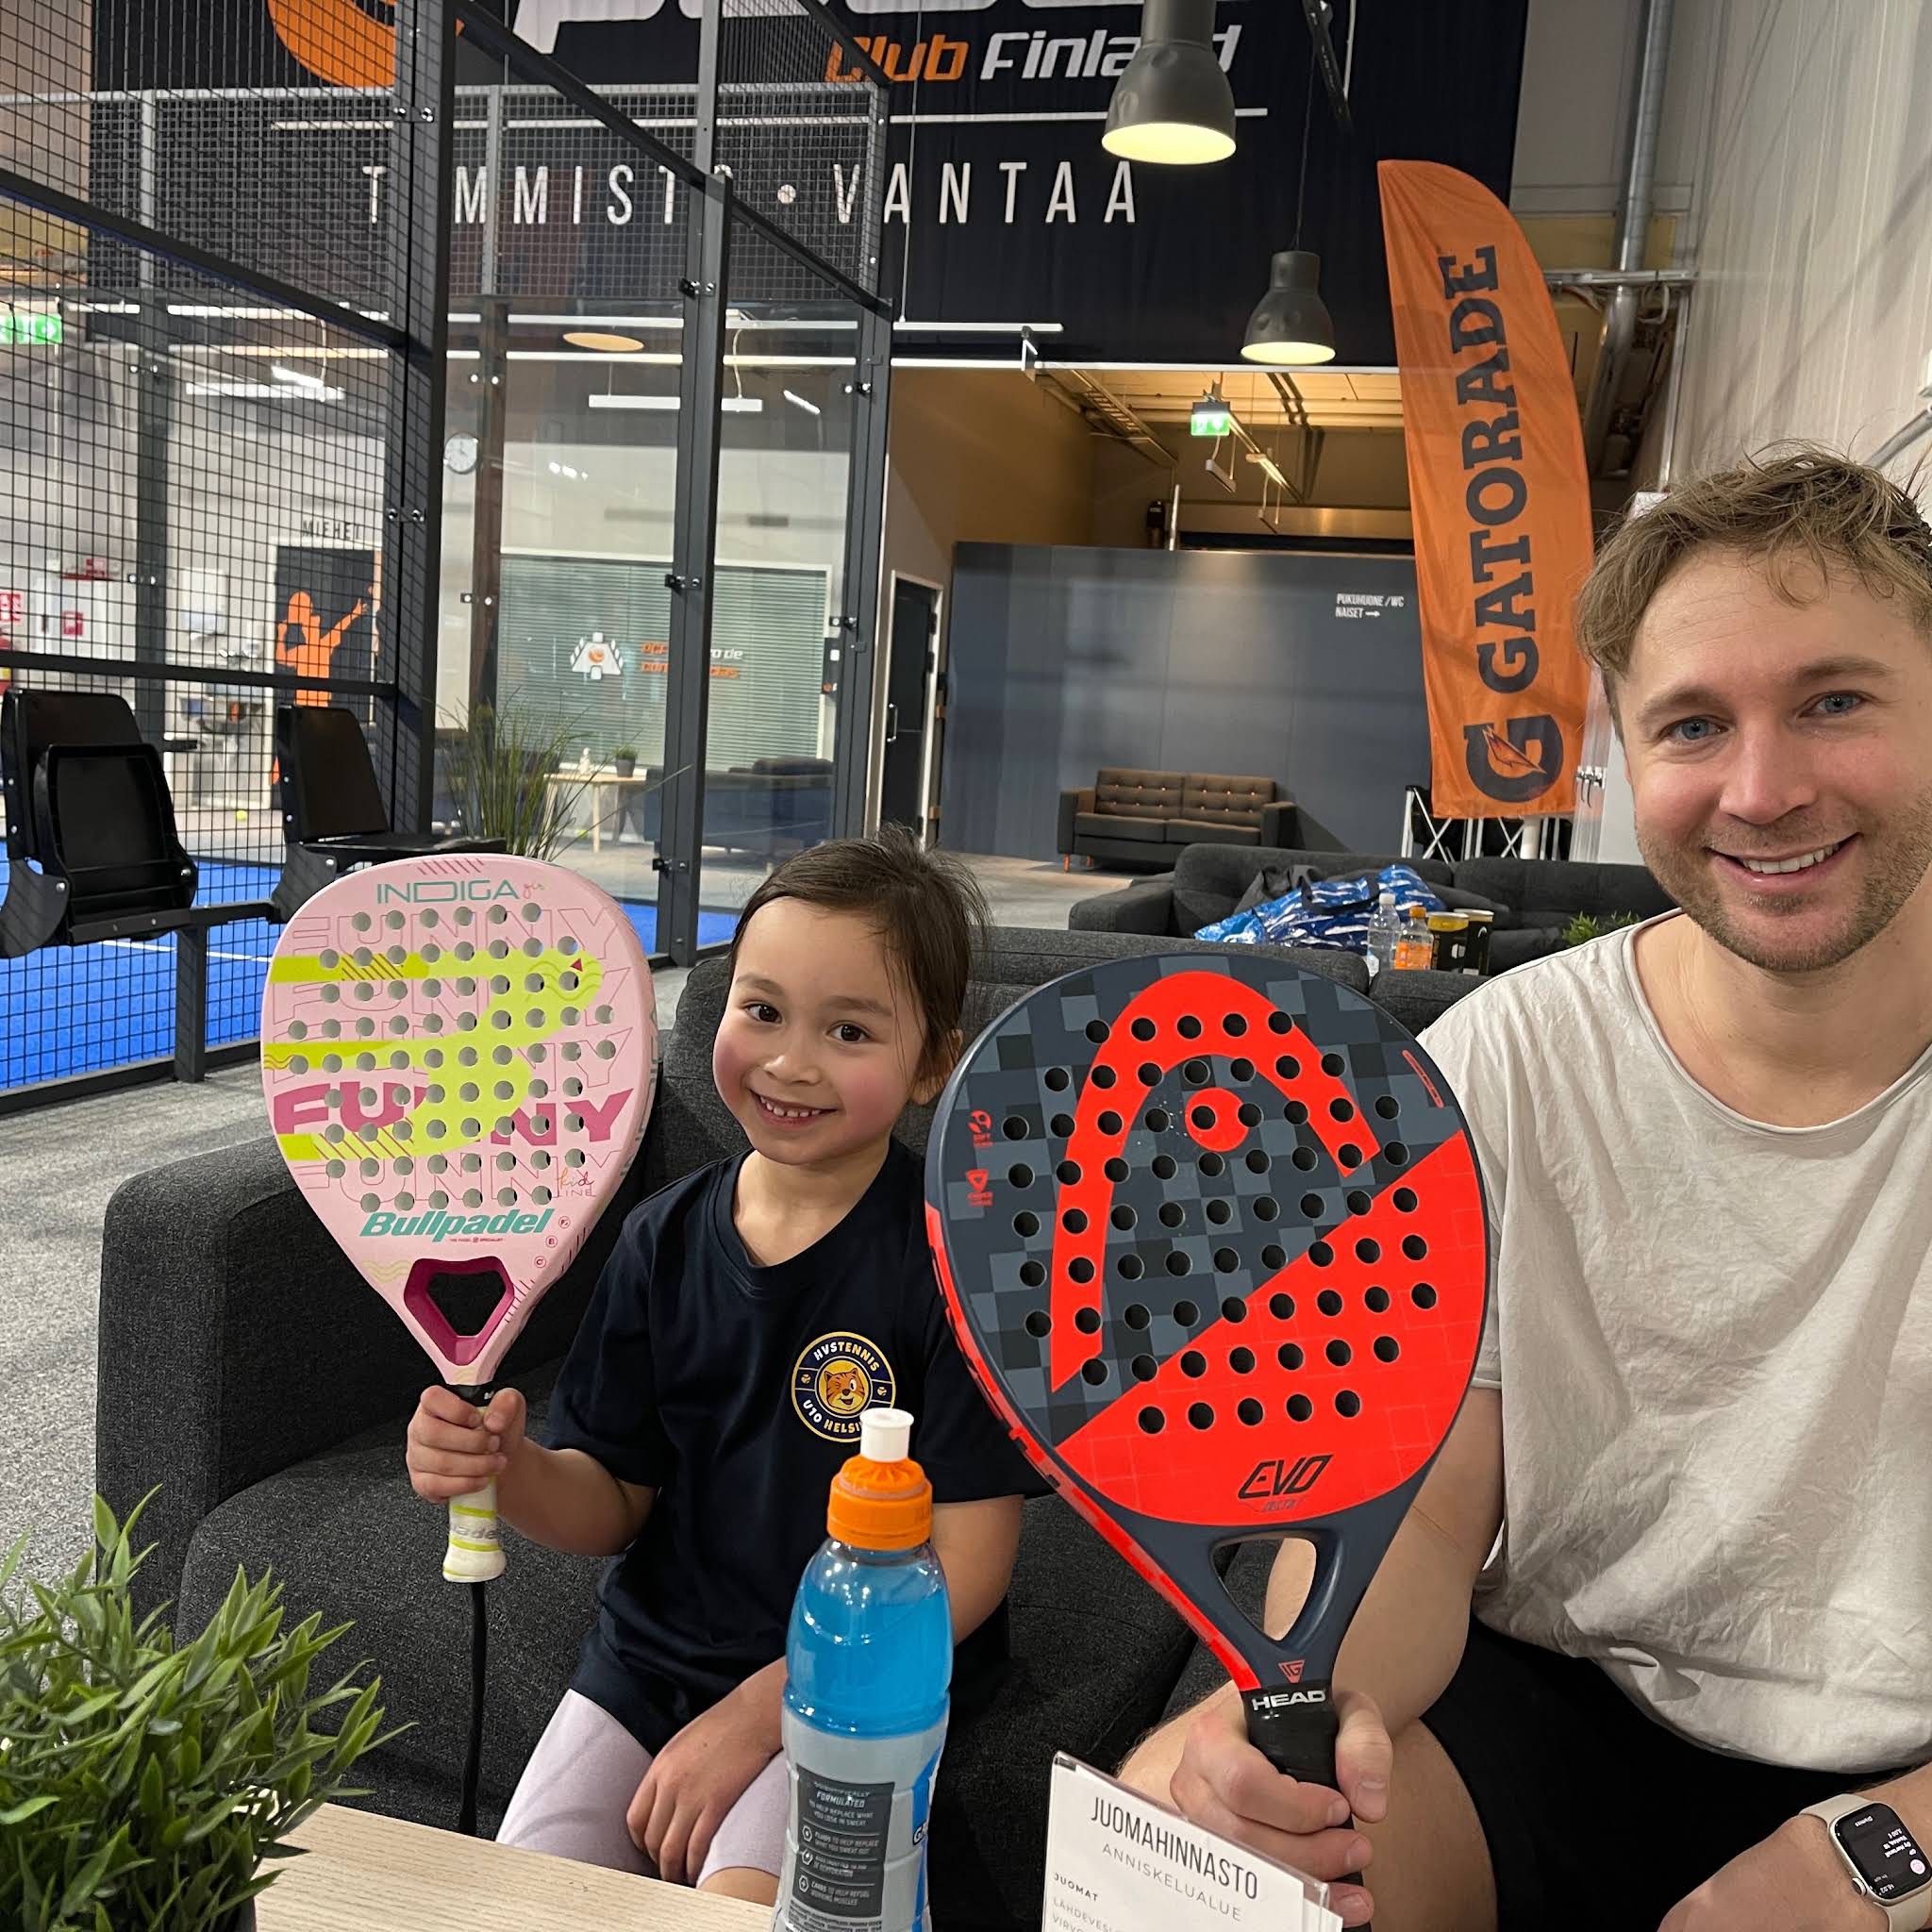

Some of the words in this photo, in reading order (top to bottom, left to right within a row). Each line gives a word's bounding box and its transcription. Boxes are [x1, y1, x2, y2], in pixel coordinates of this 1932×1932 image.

[824, 34, 969, 82] Club
[362, 164, 734, 225] TMMIST
[833, 160, 1136, 224] VANTAA
[1438, 244, 1540, 694] GATORADE
[377, 879, 519, 904] INDIGA
[274, 1080, 635, 1146] FUNY
[359, 1208, 555, 1243] Bullpadel
[812, 1341, 880, 1372] HVSTENNIS
[823, 1419, 862, 1434] HELSI
[1238, 1454, 1334, 1499] EVO
[1252, 1690, 1326, 1711] HEAD
[816, 1790, 865, 1809] FORMULATED
[1091, 1796, 1257, 1900] JUOMAHINNASTO
[1053, 1872, 1098, 1902] JUOMAT
[1102, 1842, 1242, 1923] ANNISKELUALUE
